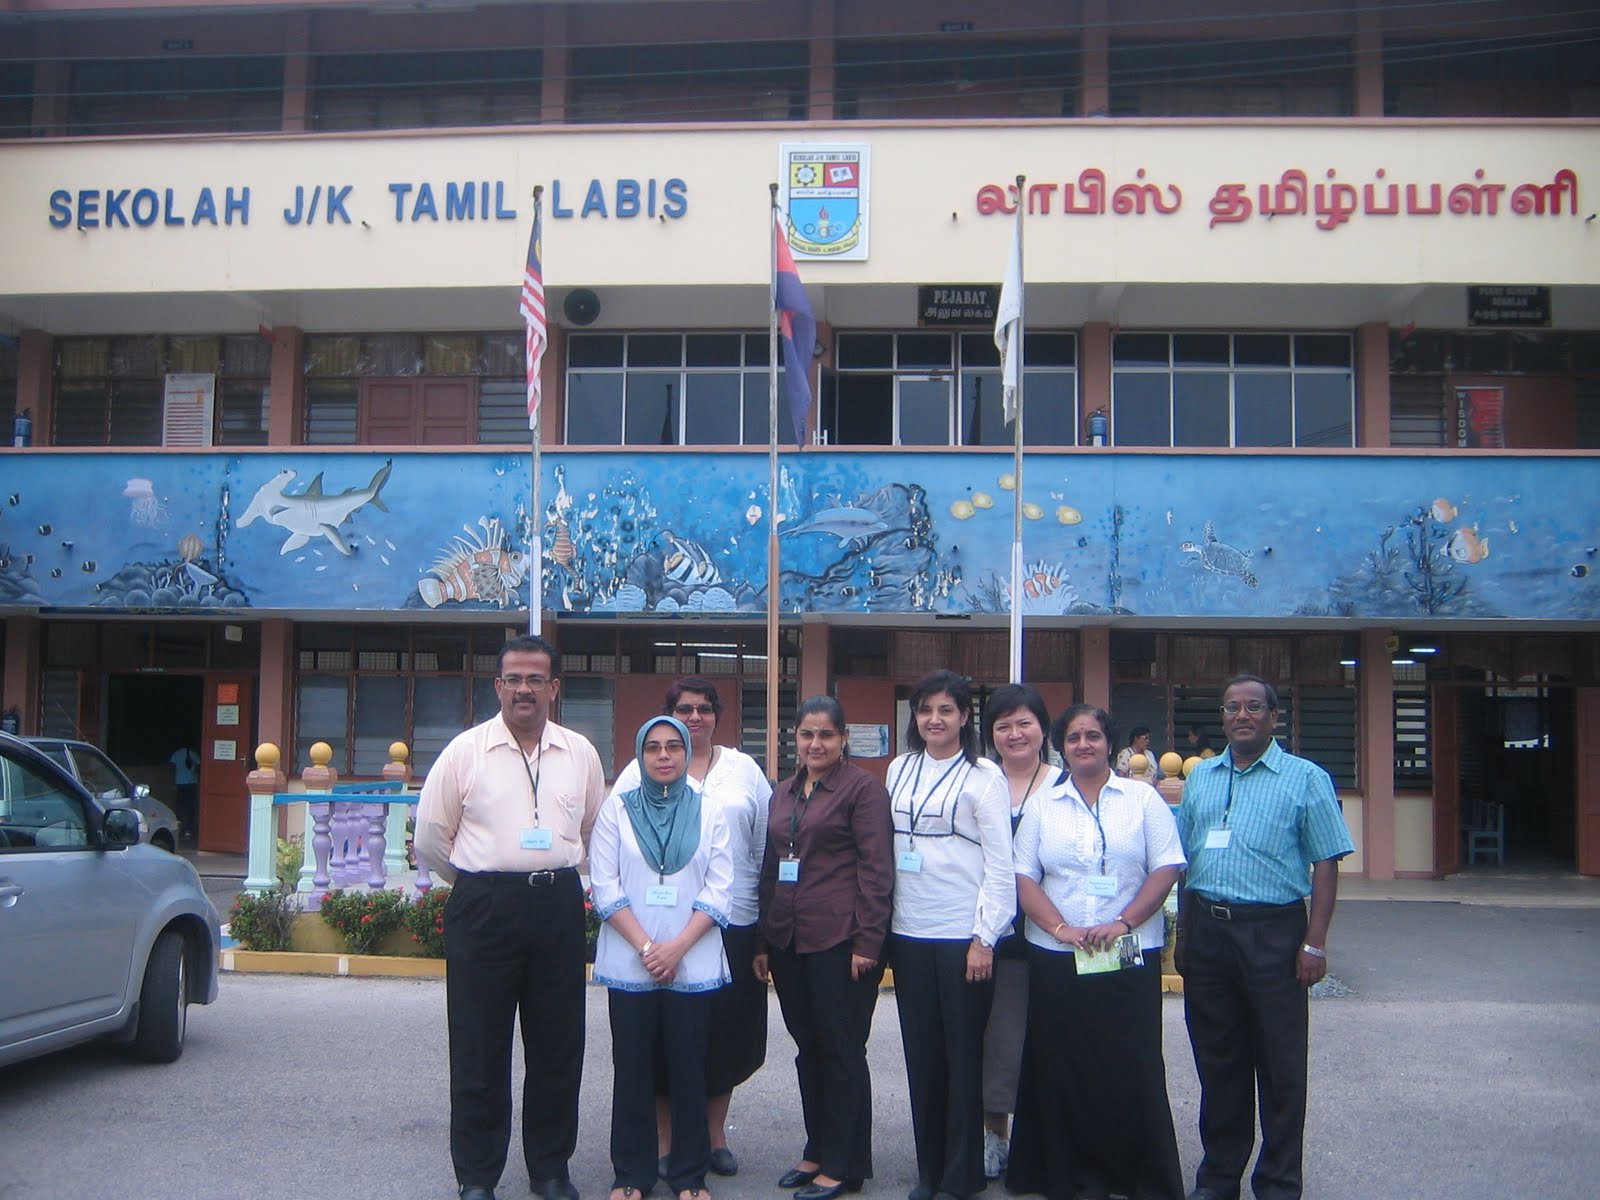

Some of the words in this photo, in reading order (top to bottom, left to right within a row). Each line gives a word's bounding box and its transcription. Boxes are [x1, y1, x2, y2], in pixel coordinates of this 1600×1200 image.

[49, 188, 250, 228] SEKOLAH
[283, 185, 353, 225] J/K
[388, 180, 517, 222] TAMIL
[552, 177, 688, 219] LABIS
[1208, 168, 1578, 231] தமிழ்ப்பள்ளி
[933, 289, 987, 305] PEJABAT
[1457, 391, 1467, 448] WISDOM
